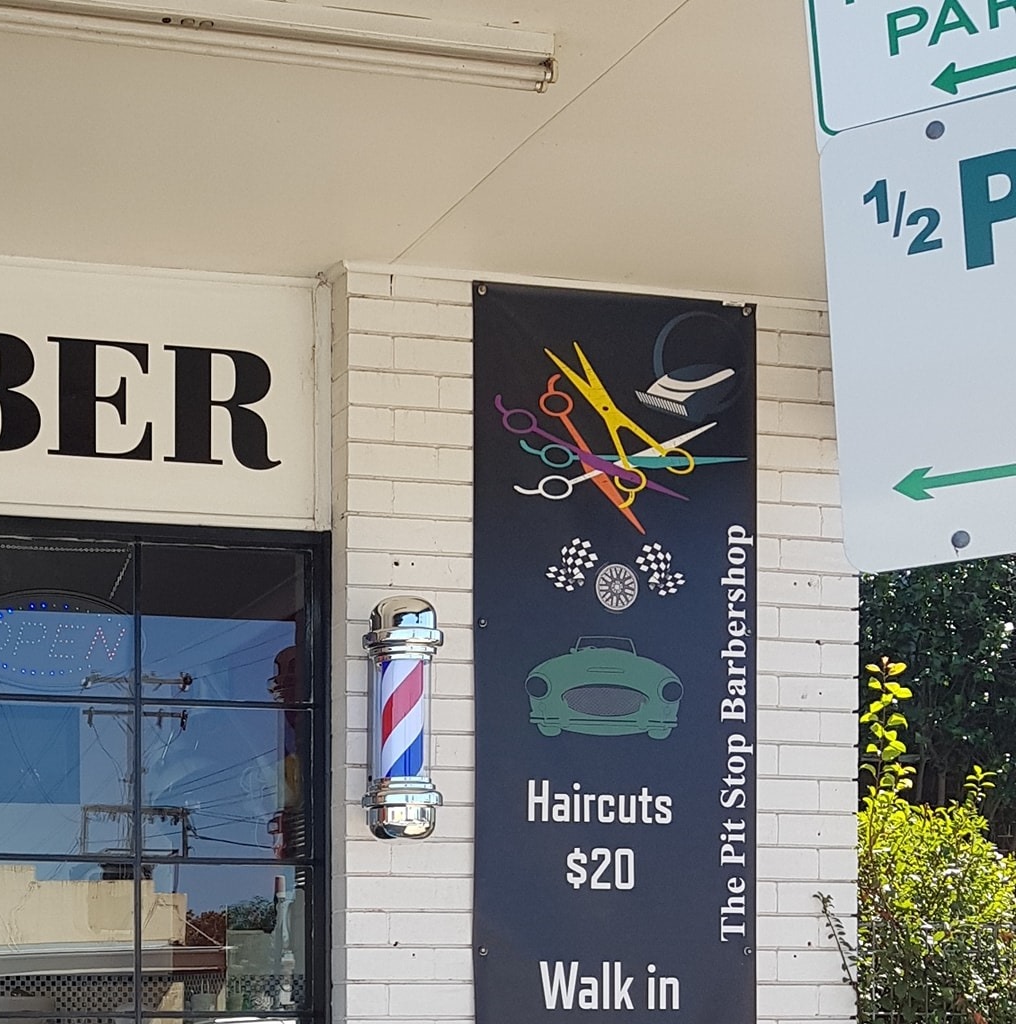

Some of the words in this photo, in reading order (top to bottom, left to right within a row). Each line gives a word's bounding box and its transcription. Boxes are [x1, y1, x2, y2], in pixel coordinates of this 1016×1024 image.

[959, 149, 1016, 270] P
[720, 524, 754, 723] Barbershop
[720, 734, 754, 809] Stop
[527, 779, 673, 825] Haircuts
[565, 847, 635, 891] $20
[720, 818, 746, 867] Pit
[720, 877, 746, 942] The
[539, 960, 636, 1011] Walk
[646, 964, 680, 1011] in
